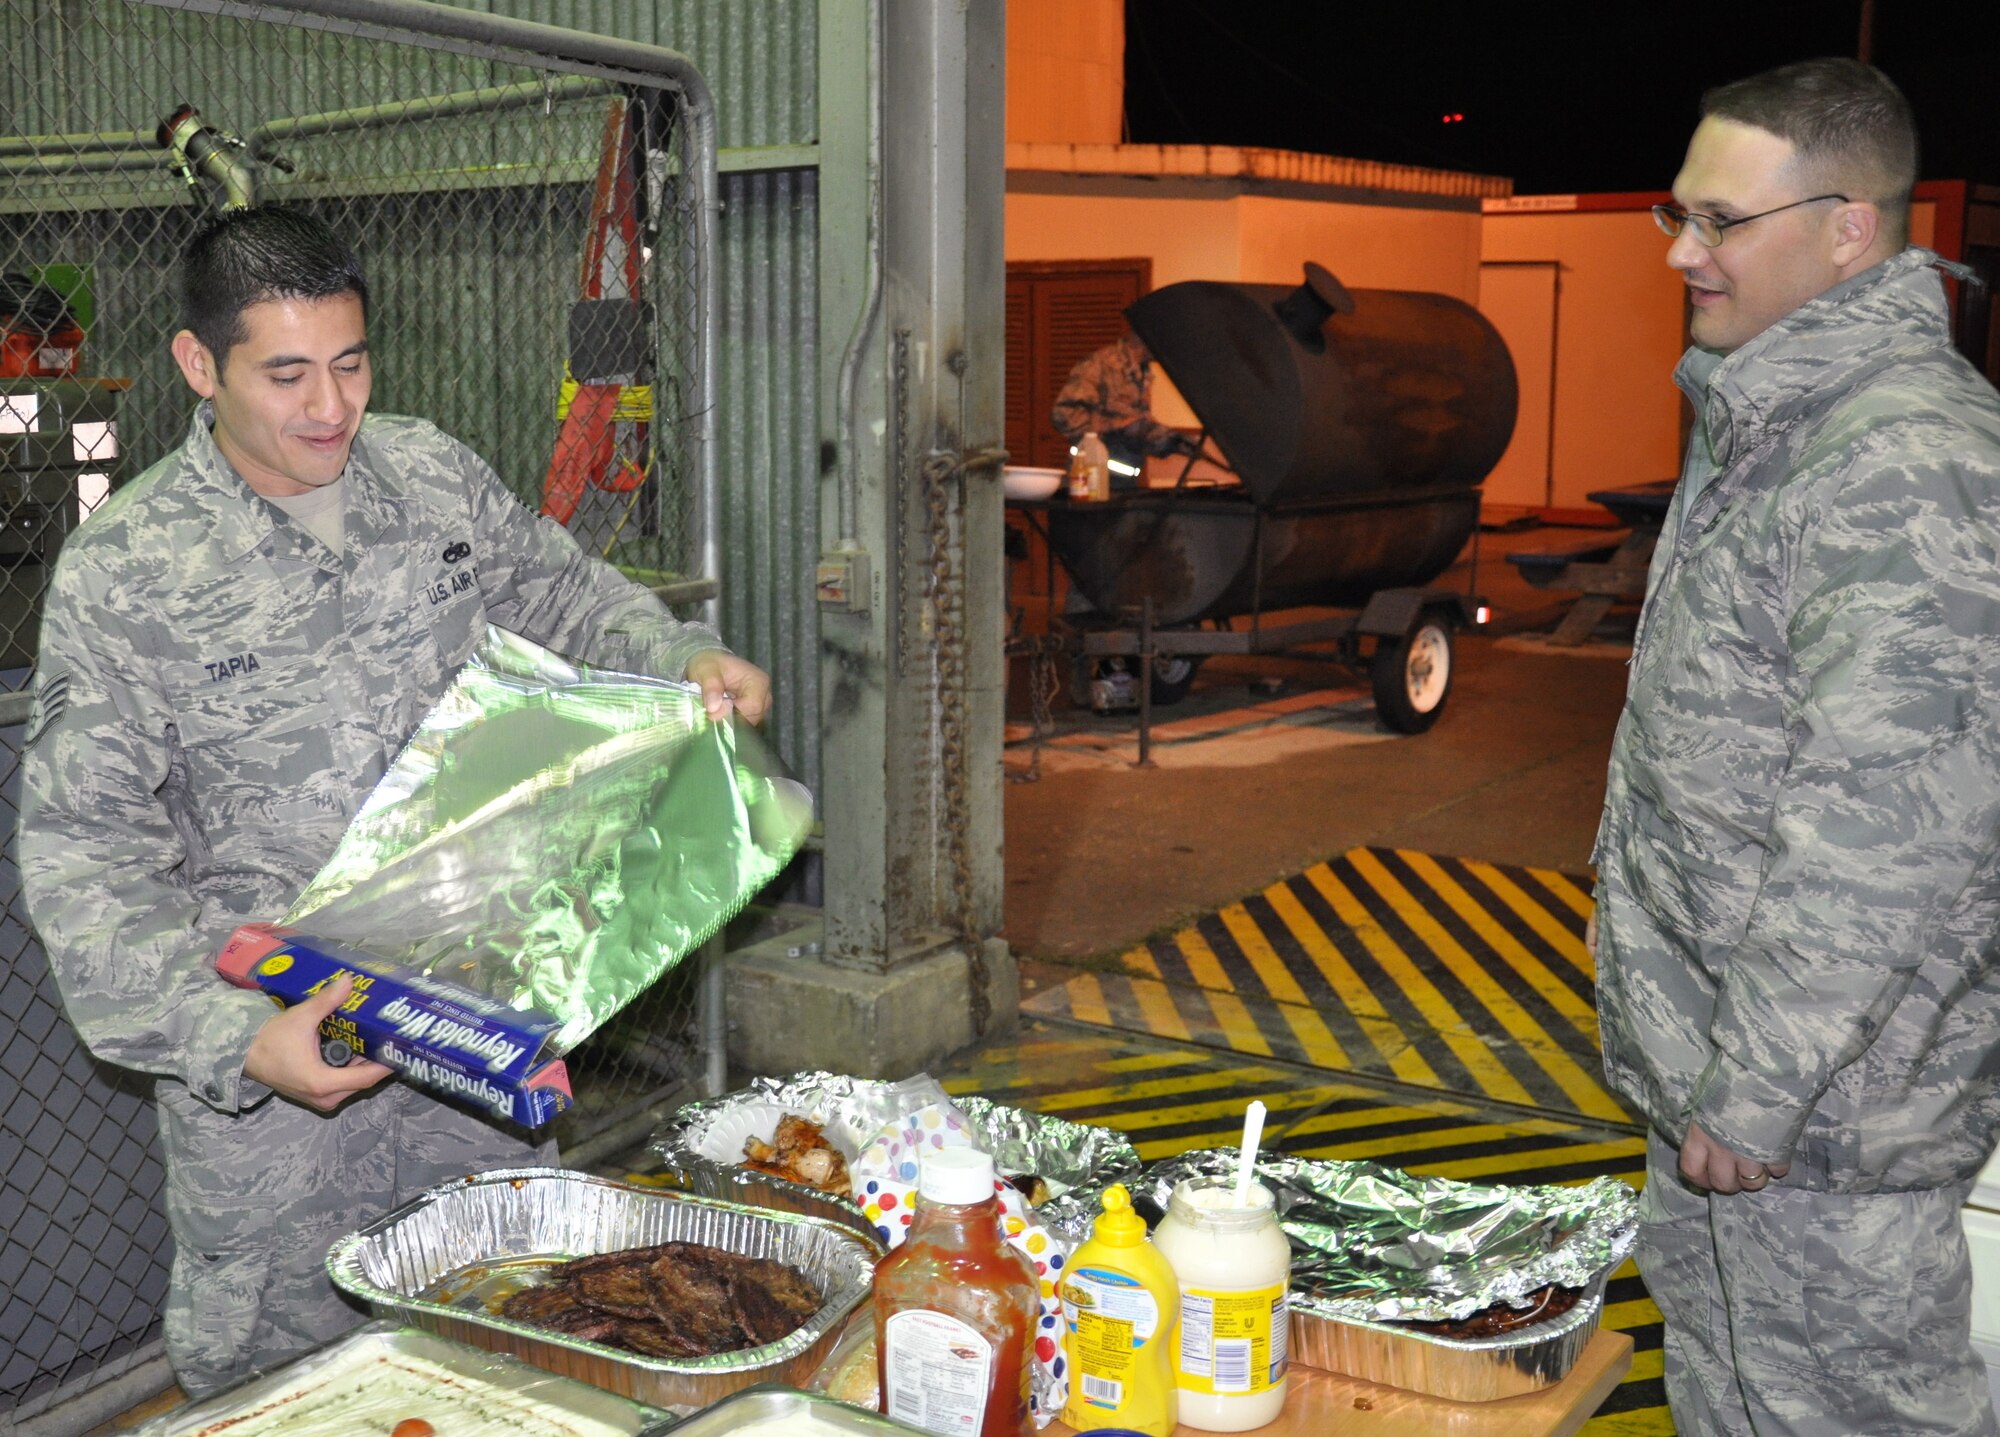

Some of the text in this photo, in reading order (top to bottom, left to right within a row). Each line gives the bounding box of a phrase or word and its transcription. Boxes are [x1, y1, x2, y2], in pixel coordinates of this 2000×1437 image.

[426, 583, 451, 606] U.S.
[451, 571, 475, 595] AIR
[204, 652, 261, 682] TAPIA
[382, 996, 438, 1038] Wrap
[443, 1004, 461, 1016] SINCE
[460, 1011, 486, 1027] TRUSTED
[425, 1050, 443, 1062] SINCE
[427, 1017, 527, 1072] Reynolds
[383, 1040, 430, 1083] Wrap
[442, 1056, 467, 1073] TRUSTED
[431, 1063, 515, 1119] Reynolds
